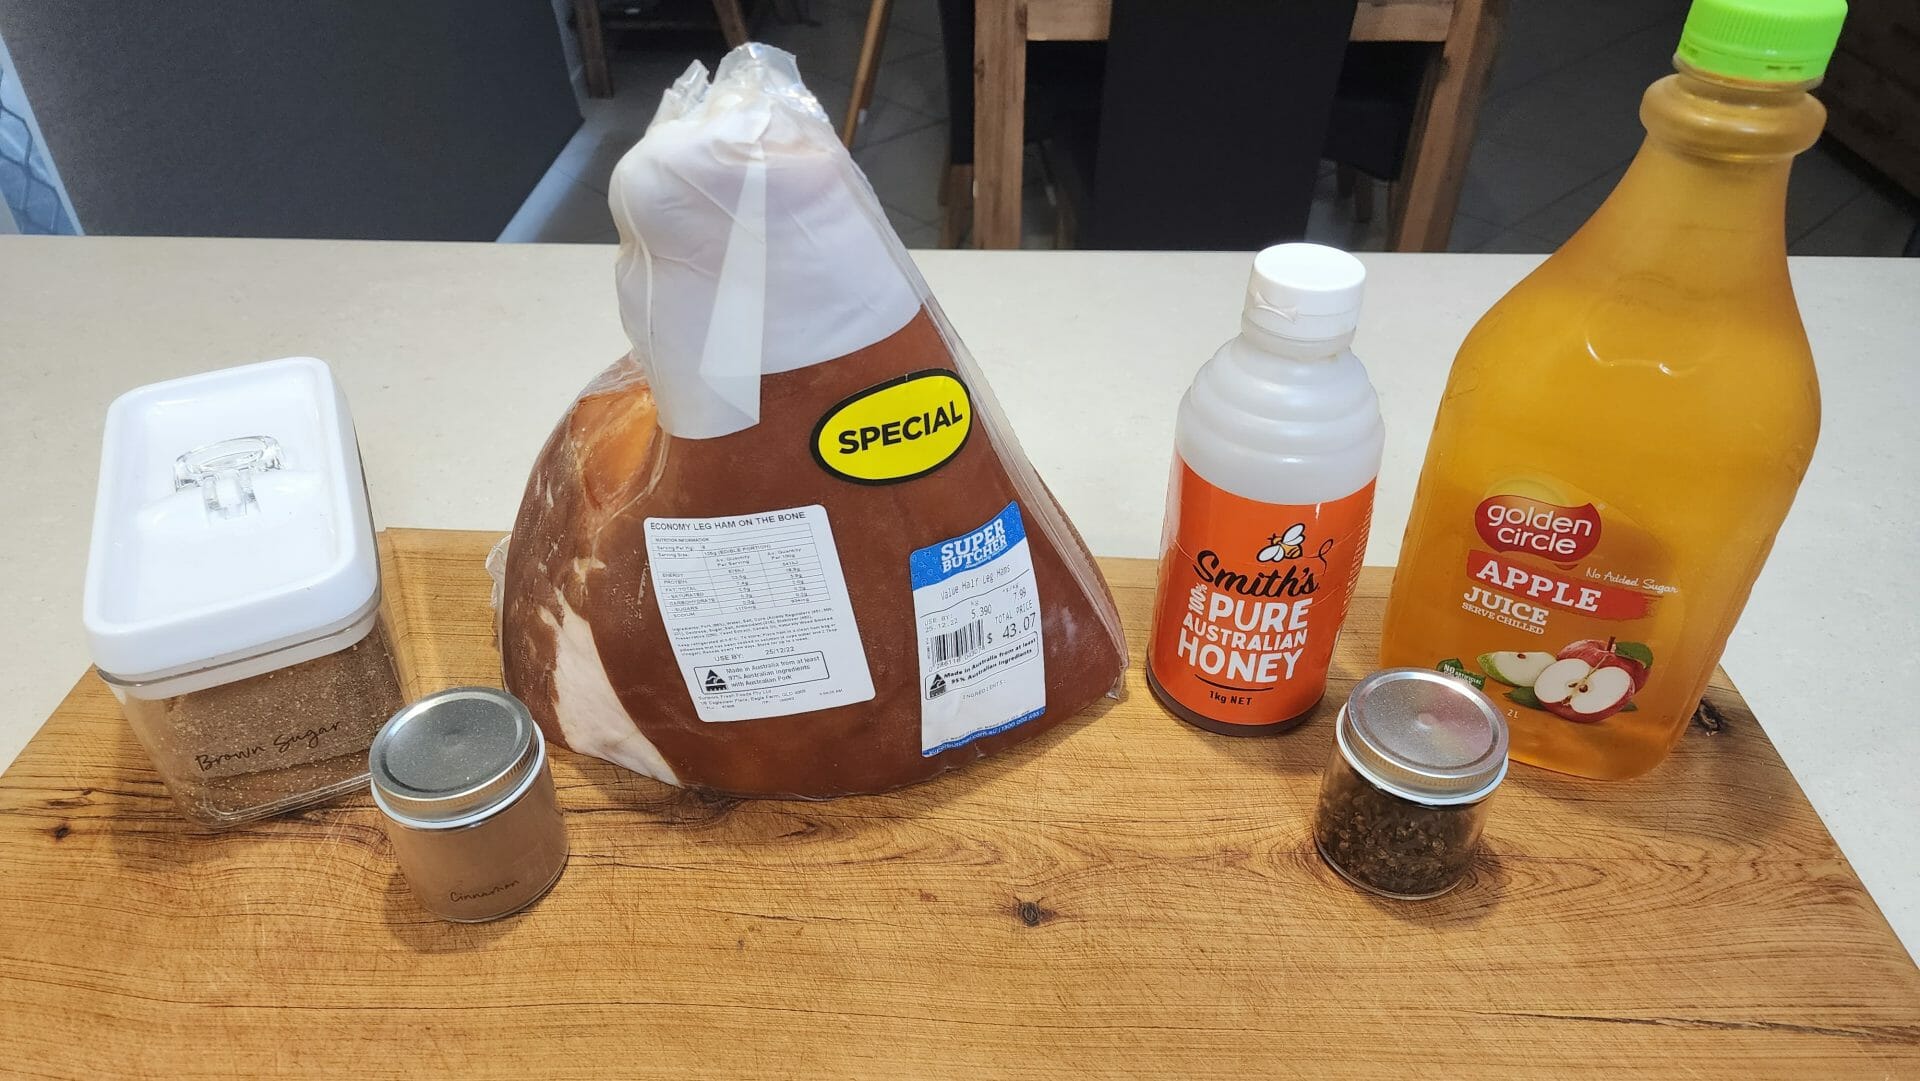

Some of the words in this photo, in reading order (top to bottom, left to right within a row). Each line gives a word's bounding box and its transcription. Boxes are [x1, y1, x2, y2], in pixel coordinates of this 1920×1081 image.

[838, 400, 962, 454] SPECIAL
[650, 522, 690, 531] ECONOMY
[715, 520, 736, 530] HAM
[738, 518, 752, 527] ON
[754, 516, 774, 525] THE
[778, 512, 806, 522] BONE
[1486, 504, 1592, 536] golden
[940, 518, 1005, 560] SUPER
[941, 535, 1007, 574] BUTCHER
[1497, 528, 1577, 555] circle
[940, 585, 959, 600] Value
[962, 577, 979, 589] Half
[982, 573, 994, 584] Leg
[1193, 550, 1320, 598] Smith's
[1476, 560, 1602, 612] APPLE
[1586, 567, 1600, 579] No
[1603, 571, 1639, 586] Added
[1642, 578, 1679, 594] Sugar
[1013, 586, 1026, 602] 7.99
[1188, 582, 1208, 616] 100%
[1464, 586, 1549, 626] JUICE
[971, 604, 992, 620] 5.390
[986, 632, 993, 644] $
[1002, 611, 1036, 639] 43.07
[995, 610, 1012, 625] TOTAL
[1016, 599, 1033, 614] PRICE
[1208, 592, 1313, 633] PURE
[1461, 601, 1496, 621] SERVE
[1496, 613, 1544, 635] CHILLED
[1182, 612, 1308, 652] AUSTRALIAN
[751, 661, 779, 670] Australia
[972, 655, 998, 669] Australia
[999, 649, 1014, 658] from
[1022, 638, 1036, 648] least
[1177, 628, 1304, 683] HONEY
[1444, 664, 1455, 674] NO
[742, 669, 774, 678] Australian
[774, 664, 810, 675] ingredients
[744, 676, 776, 686] Australian
[967, 664, 997, 679] Australian
[1209, 690, 1226, 705] 1kg
[1230, 694, 1253, 706] NET
[195, 746, 266, 772] Brown
[273, 722, 341, 754] Sugar
[450, 880, 520, 903] Cinnamon
